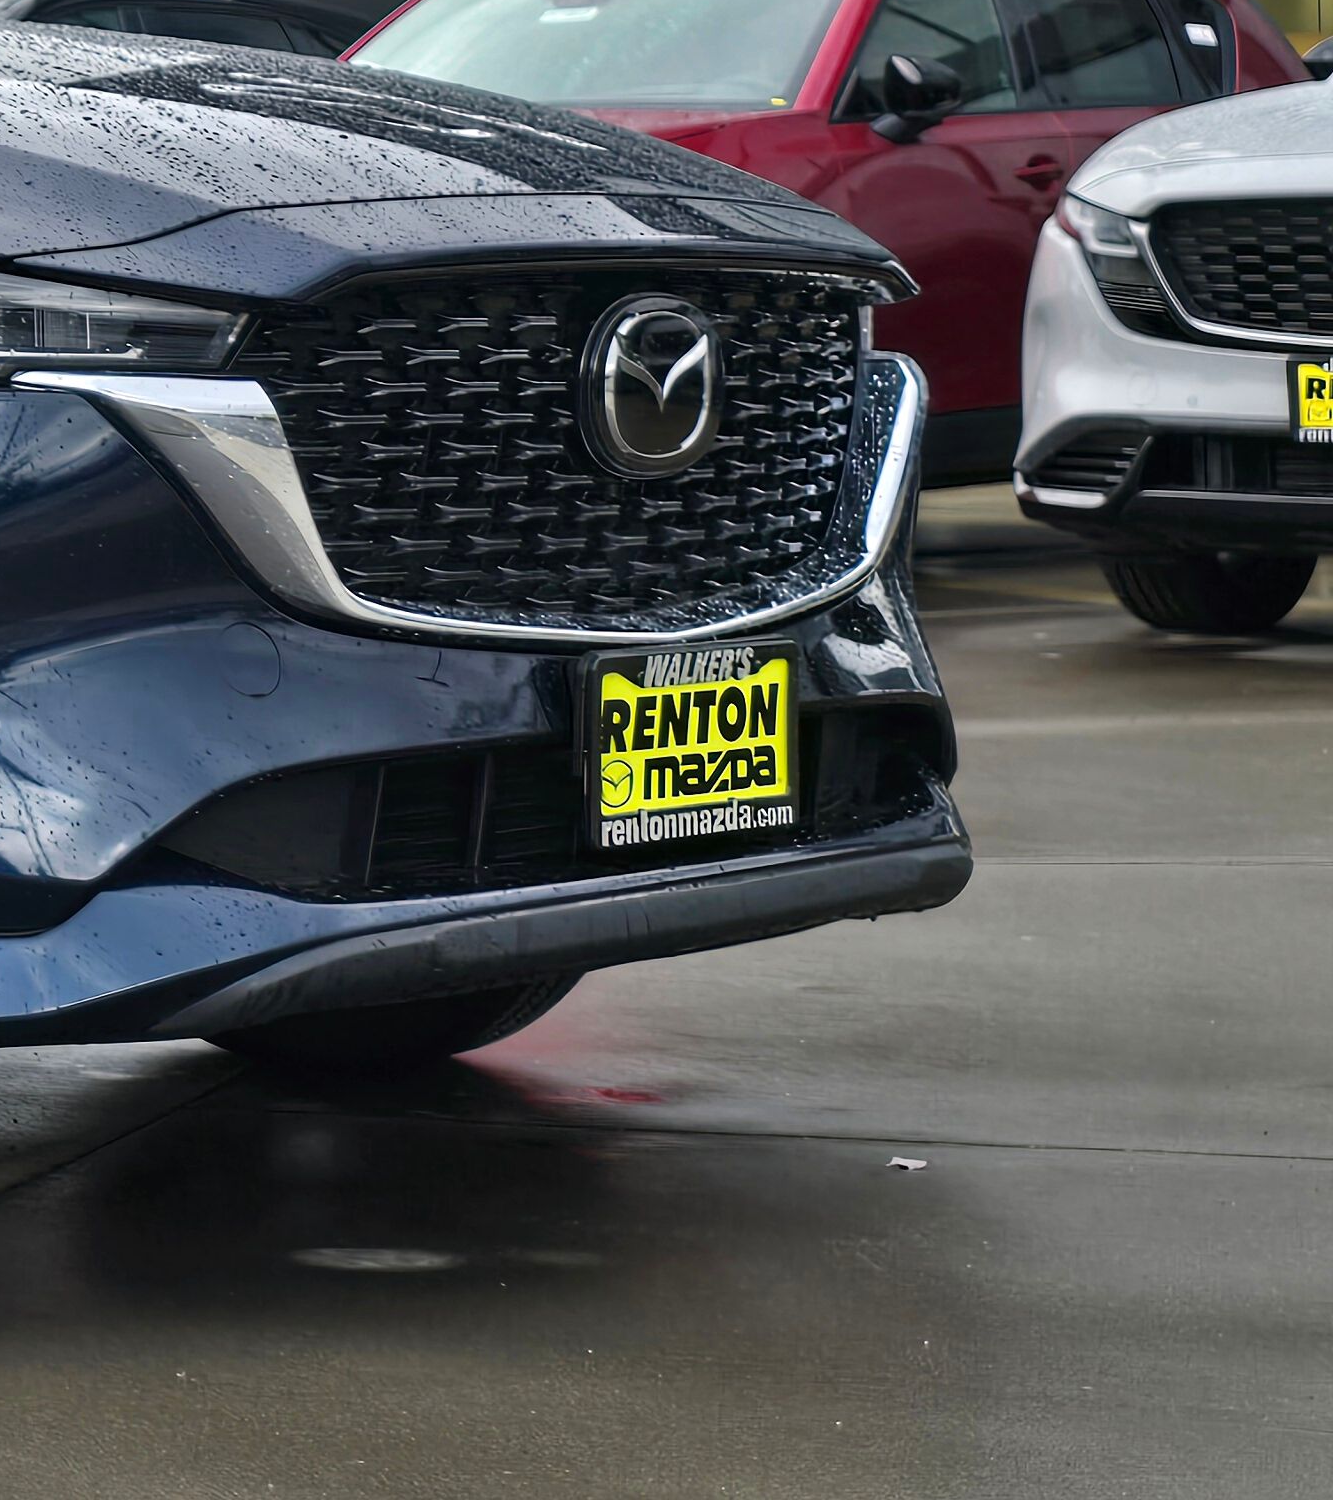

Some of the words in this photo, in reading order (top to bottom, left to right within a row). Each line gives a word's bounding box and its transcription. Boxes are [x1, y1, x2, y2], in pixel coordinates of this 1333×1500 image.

[643, 646, 755, 688] WALKER'S
[600, 682, 780, 754] RENTON
[601, 799, 794, 848] rentonmazda.com
